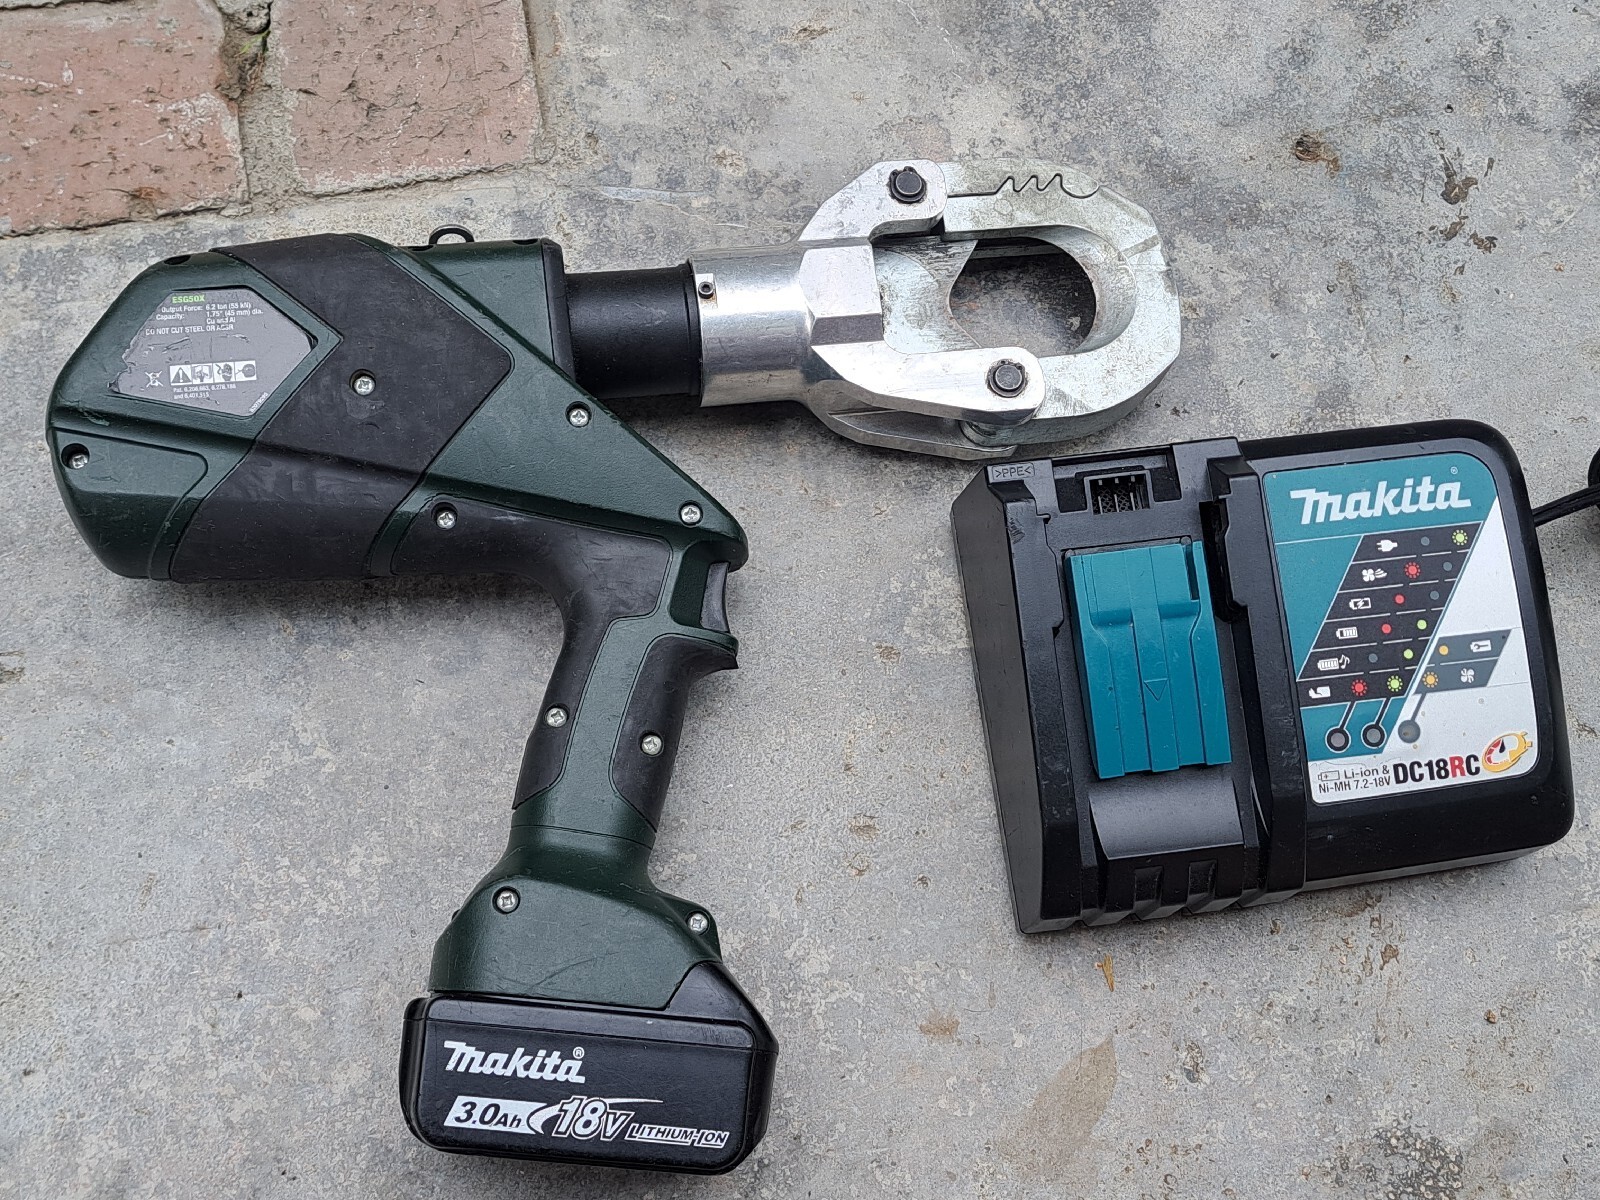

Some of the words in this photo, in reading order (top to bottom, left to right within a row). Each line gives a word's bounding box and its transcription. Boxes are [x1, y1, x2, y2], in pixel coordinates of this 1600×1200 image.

[172, 295, 205, 304] ESG50X
[156, 313, 185, 321] Capacity:
[236, 308, 251, 316] mm)
[162, 305, 182, 314] Output
[170, 326, 184, 334] CUT
[1344, 767, 1380, 780] Li-ion
[1382, 766, 1390, 776] &
[1392, 754, 1481, 784] DC18RC
[1319, 780, 1351, 794] Ni-MH
[1354, 776, 1391, 790] 7.2-18V
[454, 1101, 522, 1128] 3.0Ah
[552, 1095, 635, 1142] 18V
[624, 1122, 730, 1149] LITHIUM-ION
